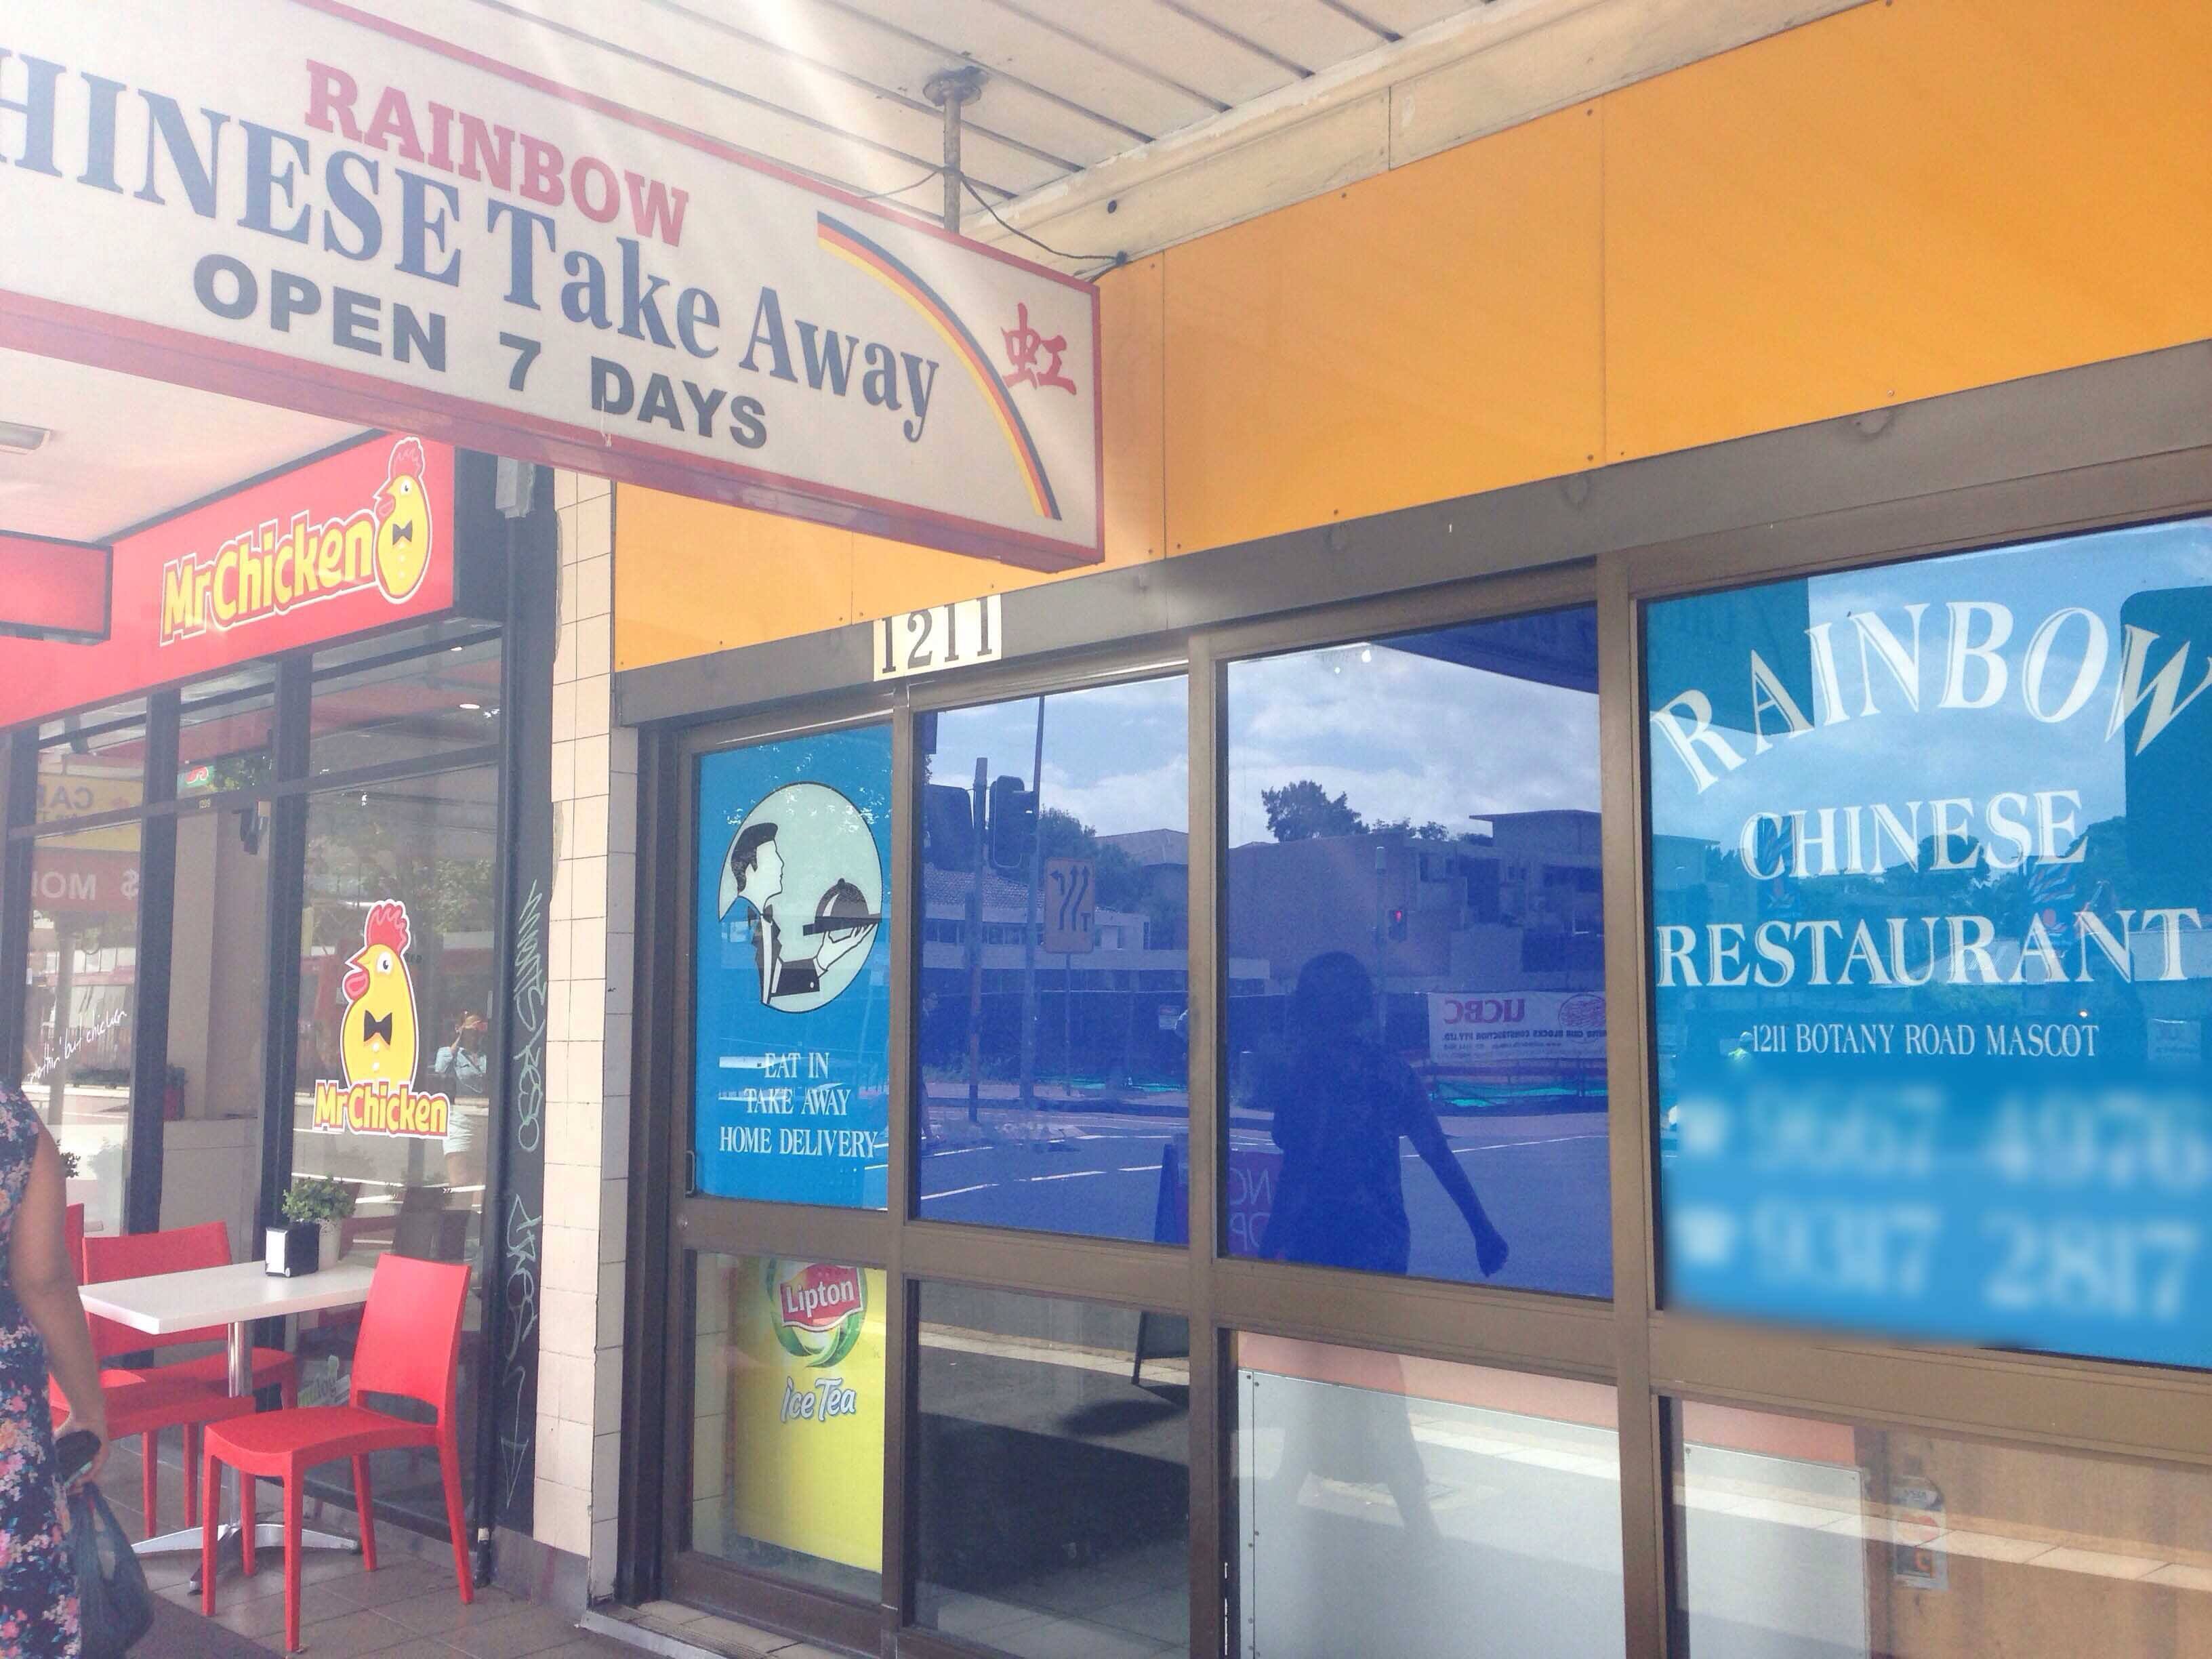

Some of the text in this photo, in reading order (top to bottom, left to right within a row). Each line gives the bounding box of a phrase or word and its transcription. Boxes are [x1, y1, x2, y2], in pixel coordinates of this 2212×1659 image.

[305, 59, 689, 247] RAINBOW
[193, 254, 767, 449] OPEN 7 DAYS
[487, 199, 720, 359] Take
[739, 286, 939, 443] Away
[1000, 302, 1076, 396] 虹
[881, 596, 992, 674] 1211
[1650, 601, 2212, 794] RAINBOW
[1740, 790, 2088, 881] CHINESE
[1656, 907, 2201, 987] RESTAURANT
[764, 1052, 830, 1080] EAT IN
[1752, 1024, 2100, 1057] 1211 BOTANY ROAD MASCOT
[719, 1126, 879, 1158] HOME DELIVERY
[745, 1088, 852, 1116] TAKE AWAY
[786, 1279, 856, 1318] Lipton
